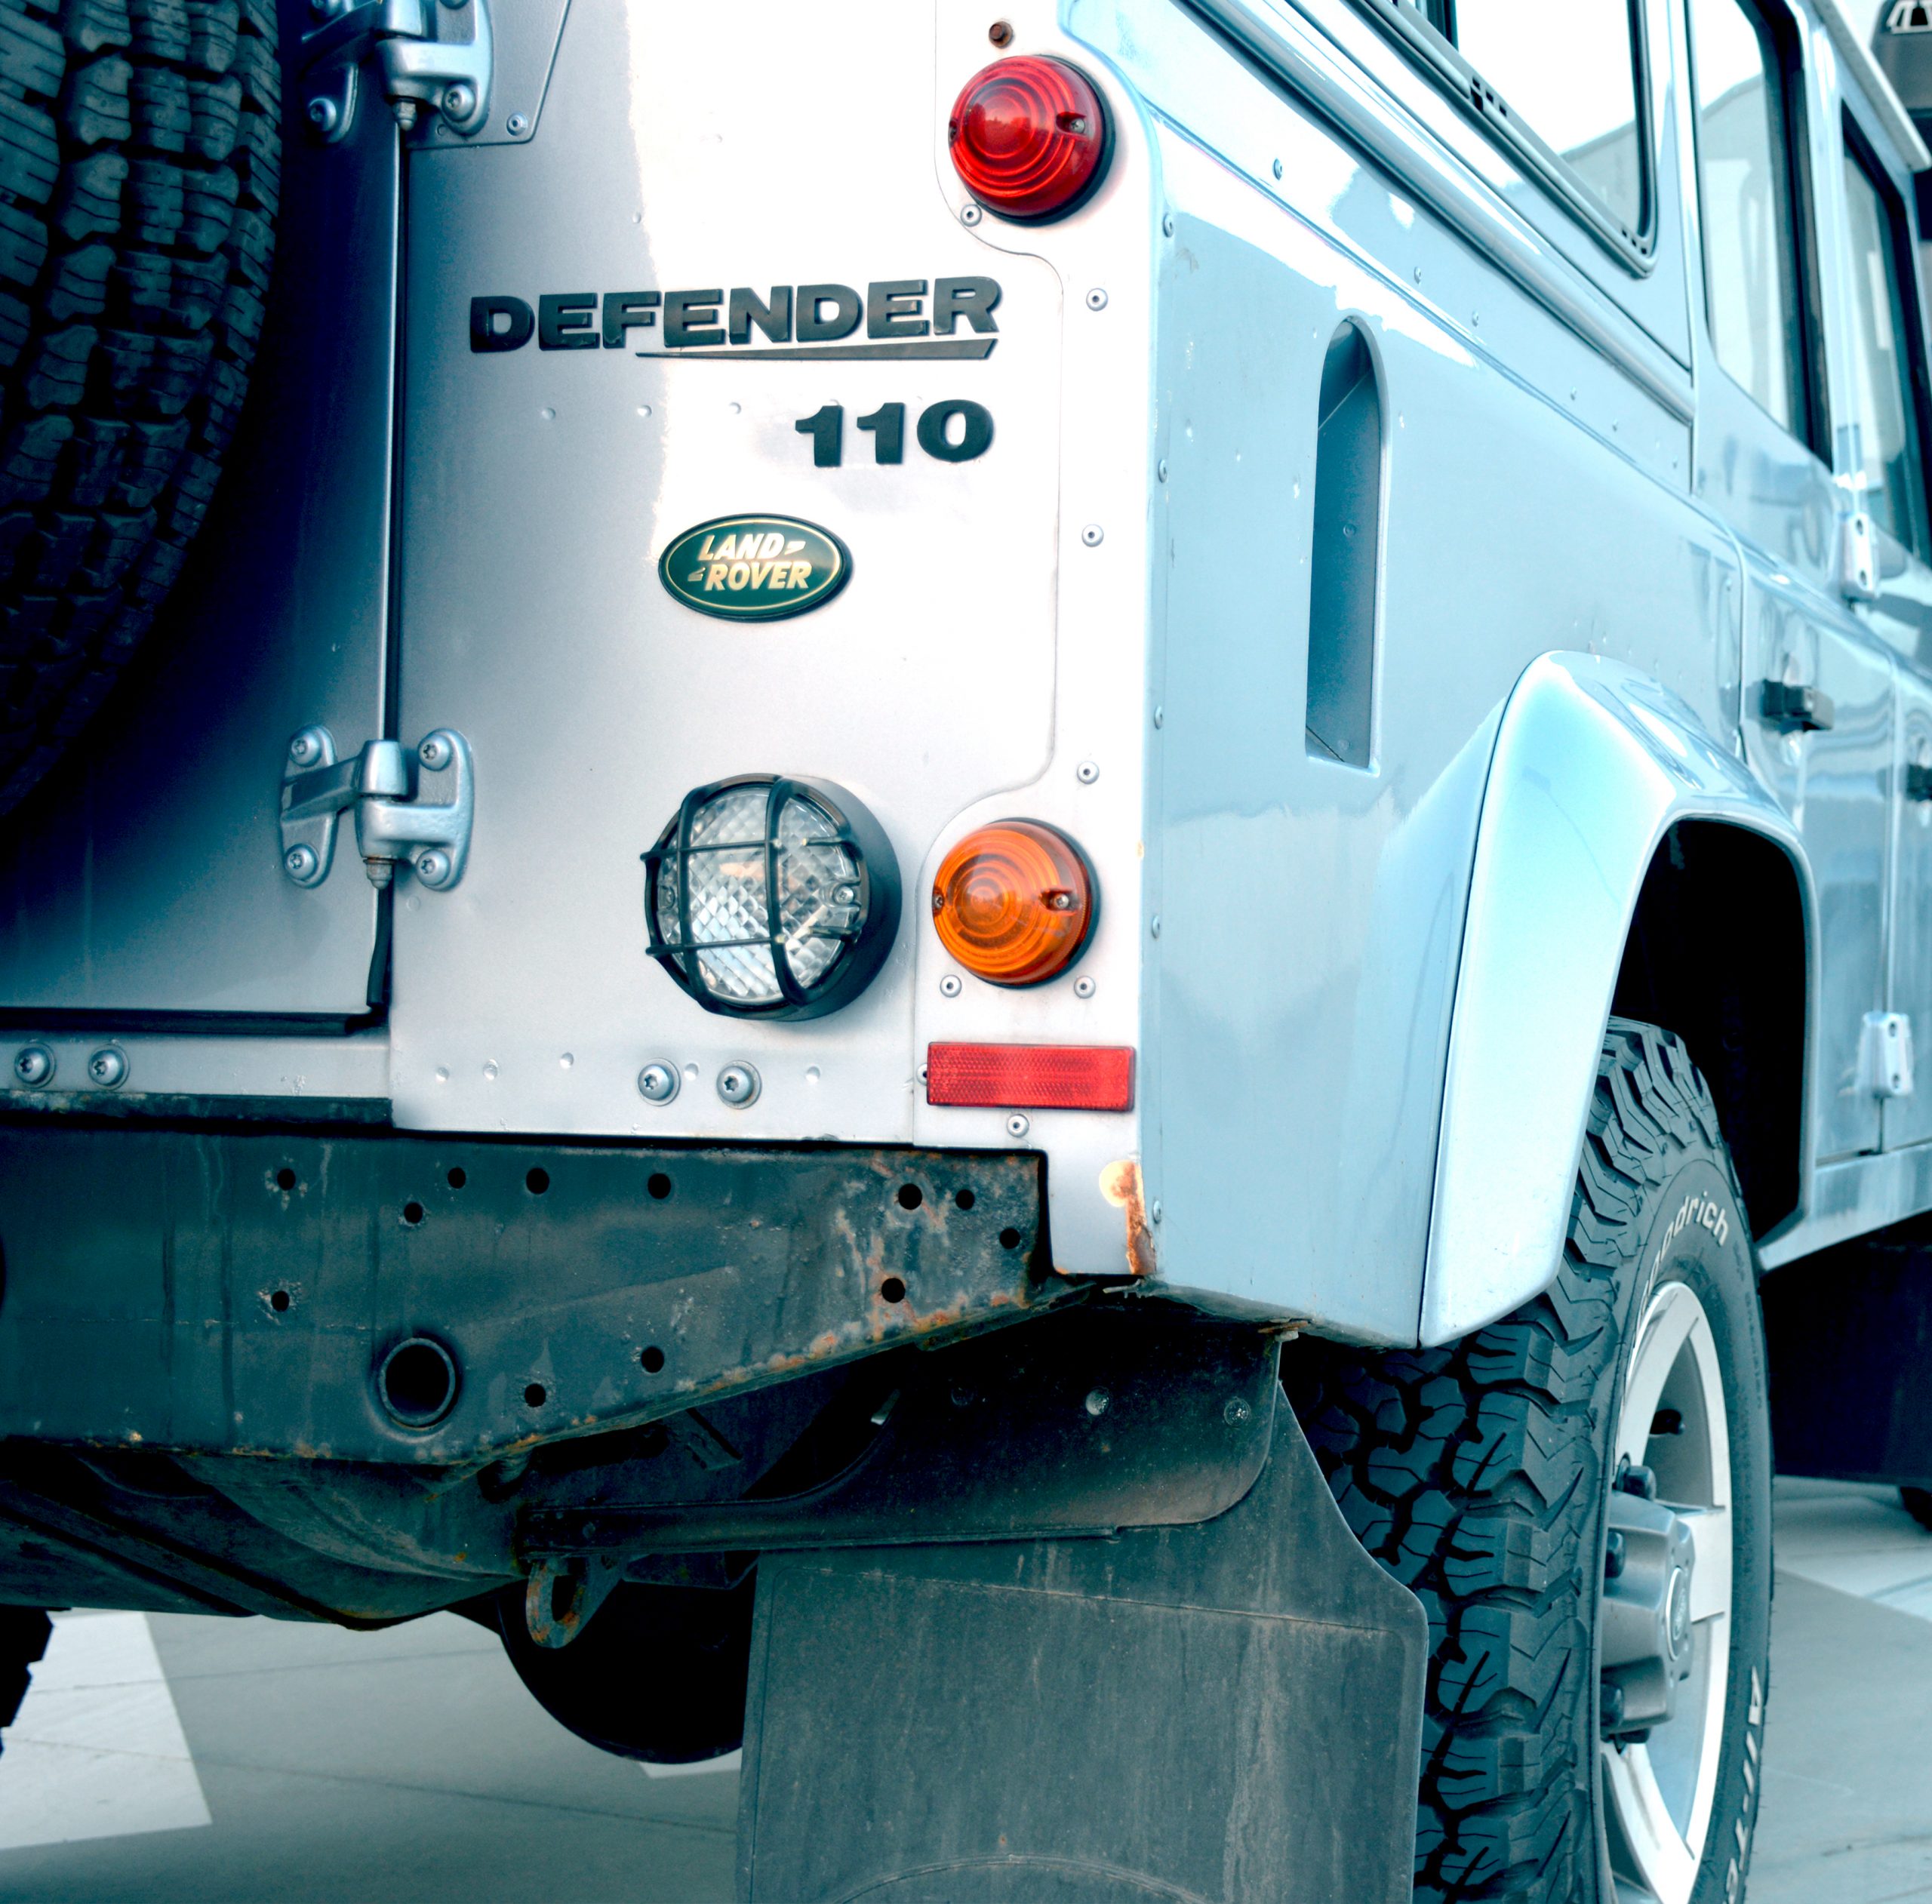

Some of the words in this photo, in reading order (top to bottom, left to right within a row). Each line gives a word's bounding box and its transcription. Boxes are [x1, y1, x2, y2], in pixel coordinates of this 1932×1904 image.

[469, 276, 1002, 352] DEFENDER
[795, 399, 994, 467] 110
[698, 533, 785, 561] LAND
[704, 561, 812, 591] ROVER
